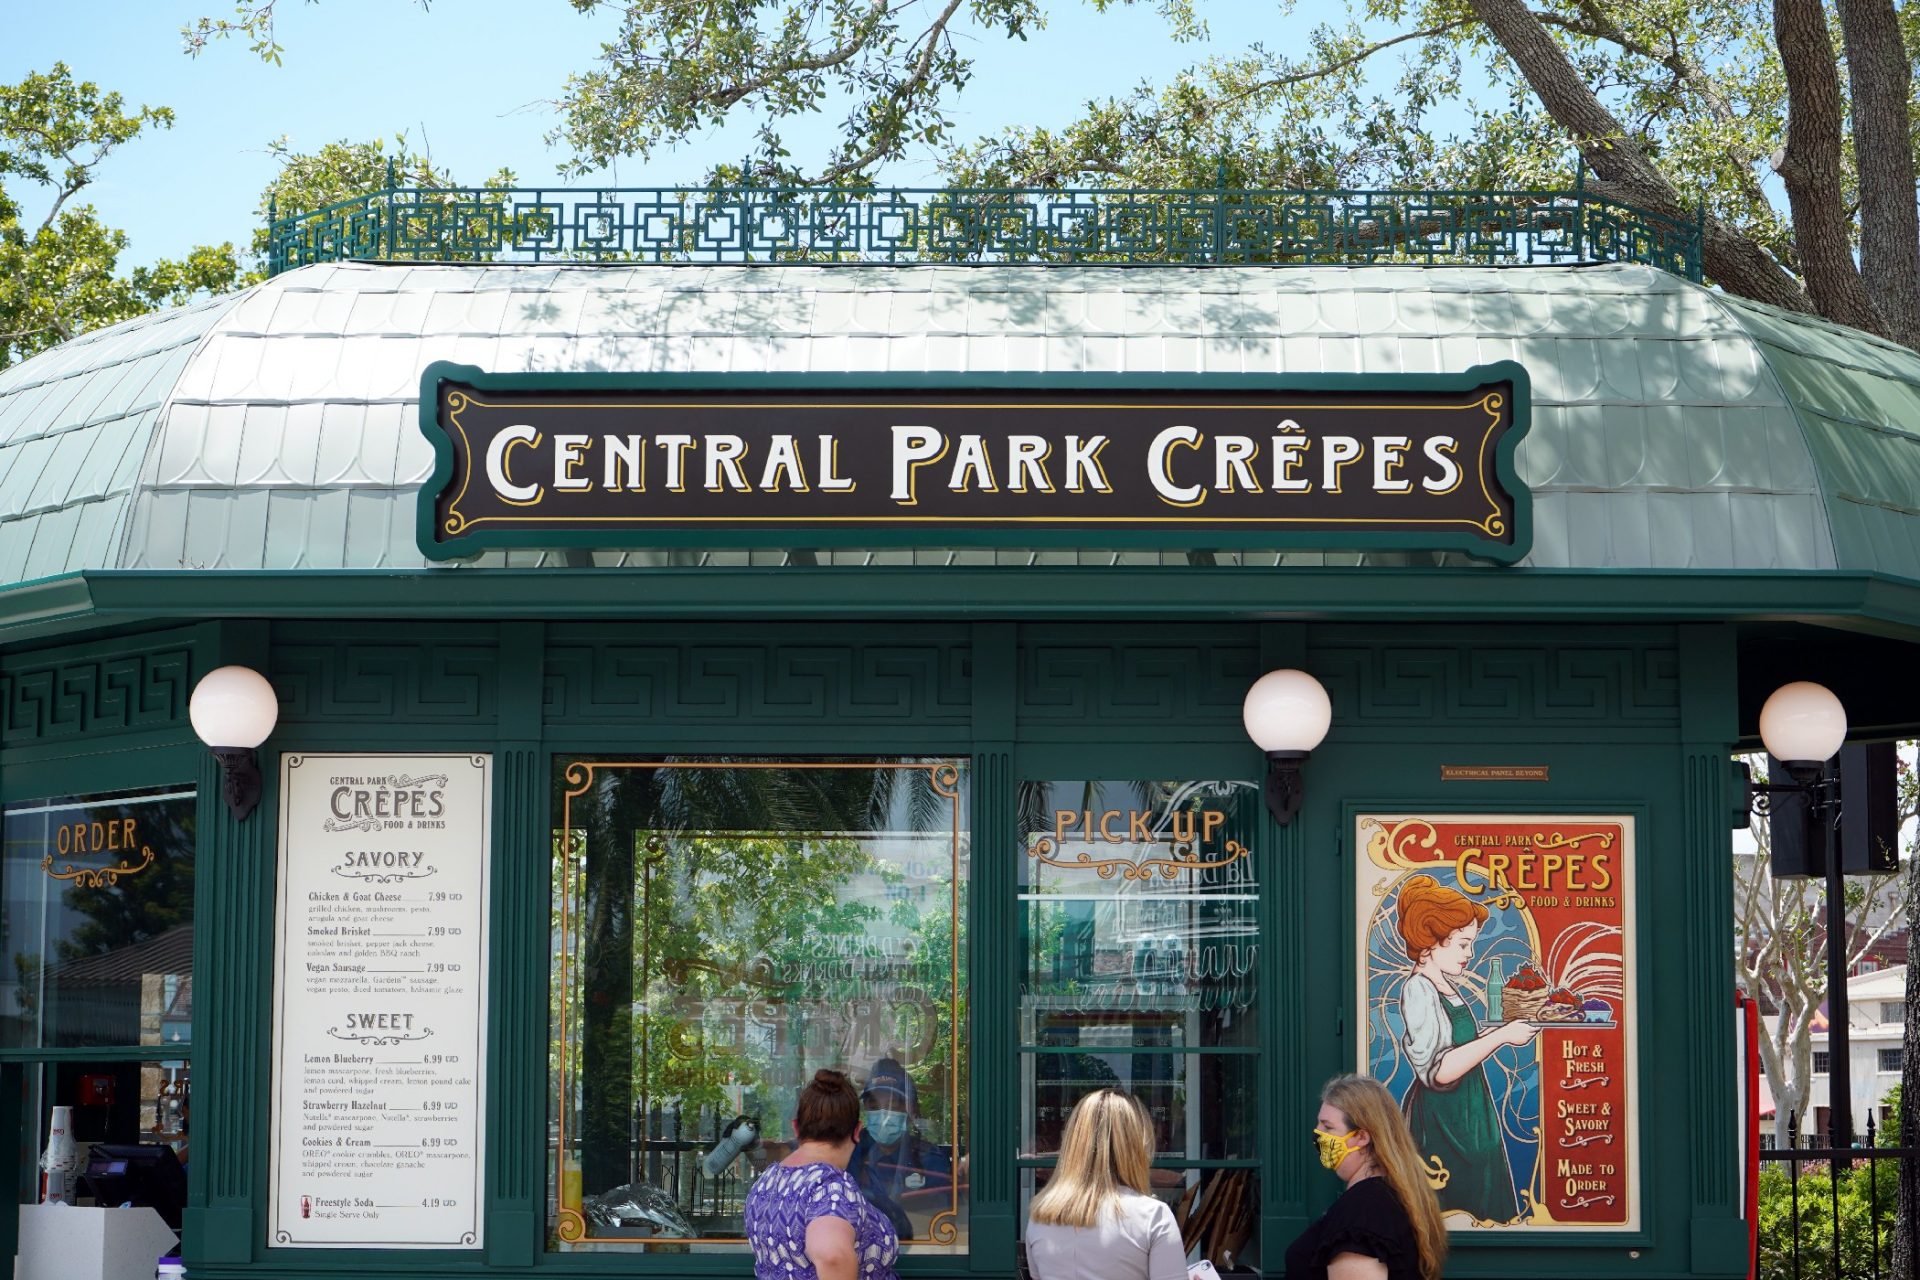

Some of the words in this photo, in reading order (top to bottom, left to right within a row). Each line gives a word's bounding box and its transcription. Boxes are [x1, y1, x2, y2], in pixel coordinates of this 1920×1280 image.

[485, 424, 856, 506] CENTRAL
[890, 425, 1113, 506] PARK
[1147, 418, 1464, 507] CRÊPES
[329, 776, 365, 785] CENTRAL
[366, 776, 387, 785] PARK
[330, 786, 447, 822] CRÊPES
[383, 820, 404, 829] FOOD
[407, 820, 413, 829] &
[416, 820, 446, 829] DRINKS
[1055, 810, 1157, 844] PICK
[1172, 810, 1226, 844] UP
[57, 818, 136, 855] ORDER
[1454, 834, 1501, 846] CENTRAL
[1505, 834, 1532, 846] PARK
[344, 851, 424, 868] SAVORY
[1455, 847, 1613, 895] CRÊPES
[308, 891, 340, 901] Chicken
[343, 892, 349, 901] &
[353, 891, 371, 901] Goat
[374, 892, 402, 902] Cheese
[428, 891, 446, 902] 7.99
[1530, 896, 1558, 907] FOOD
[1563, 896, 1570, 907] &
[1576, 896, 1615, 908] DRINKS
[307, 926, 339, 936] Smoked
[341, 926, 371, 936] Brisket
[428, 926, 445, 936] 7.99
[306, 962, 330, 973] Vegan
[332, 962, 366, 973] Sausage
[427, 963, 445, 973] 7.99
[346, 1013, 414, 1030] SWEET
[1562, 1040, 1589, 1059] HOT
[1592, 1044, 1602, 1058] &
[304, 1053, 331, 1064] Lemon
[334, 1053, 374, 1065] Blueberry
[424, 1054, 442, 1064] 6.99
[1566, 1060, 1605, 1078] FRESH
[302, 1099, 349, 1111] Strawberry
[351, 1100, 387, 1110] Hazelnut
[423, 1101, 441, 1111] 6.99
[1557, 1100, 1598, 1119] SWEET
[1601, 1102, 1611, 1116] &
[1565, 1118, 1610, 1137] SAVORY
[302, 1136, 333, 1147] Cookies
[335, 1136, 342, 1147] &
[345, 1136, 371, 1147] Cream
[421, 1137, 441, 1147] 6.99
[1557, 1158, 1593, 1178] MADE
[1600, 1163, 1615, 1175] TO
[1565, 1178, 1607, 1197] ORDER
[315, 1197, 351, 1208] Freestyle
[354, 1197, 374, 1207] Soda
[421, 1198, 440, 1208] 4.19
[314, 1210, 337, 1219] Single
[339, 1210, 361, 1219] Serve
[362, 1210, 380, 1220] Only
